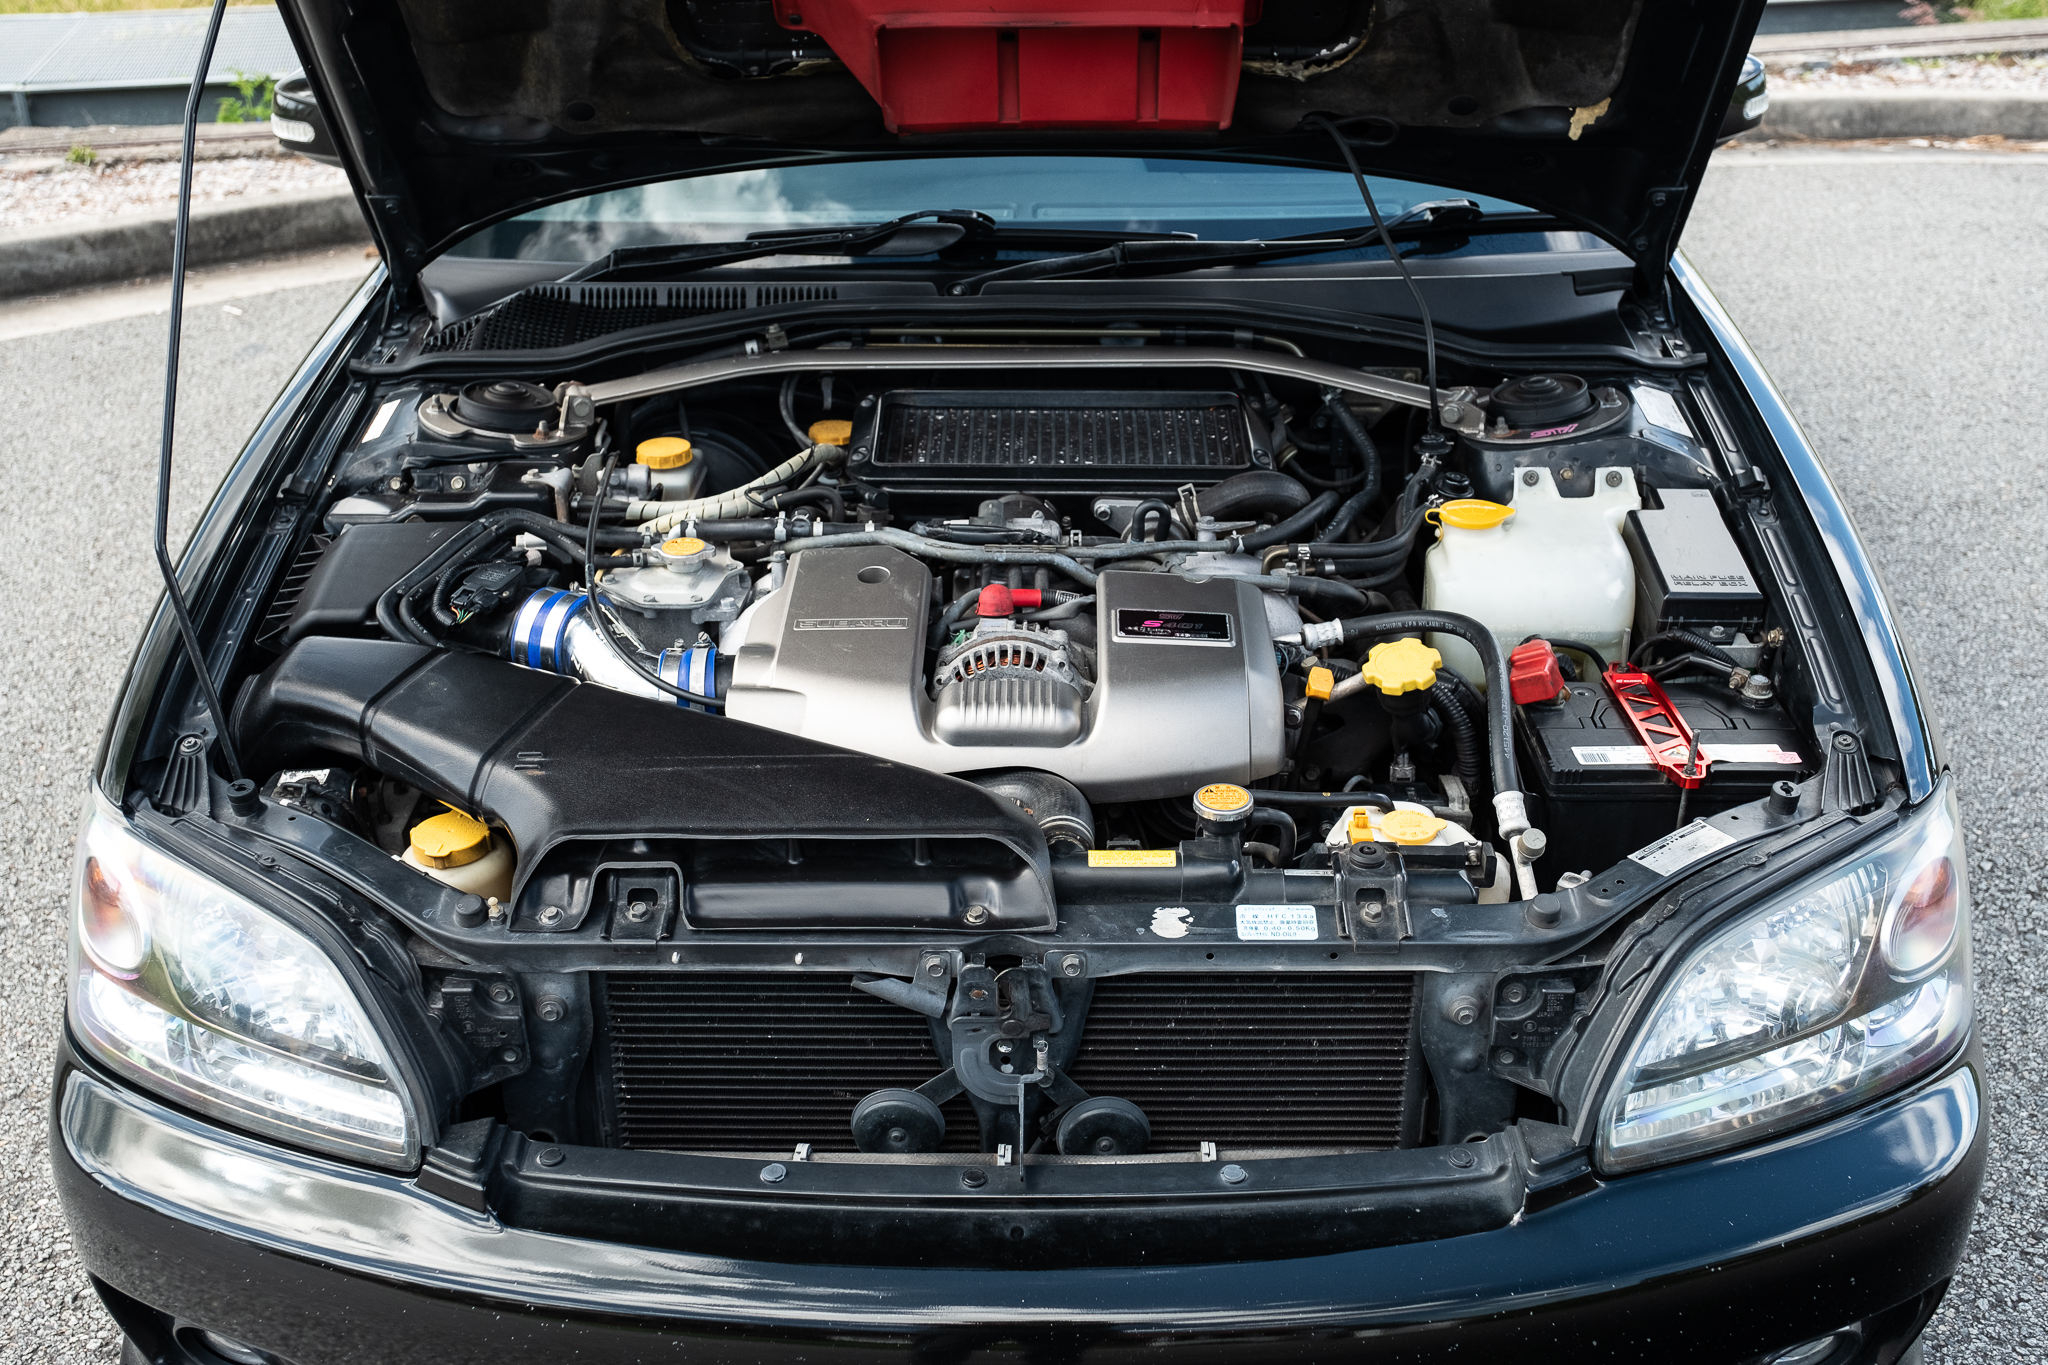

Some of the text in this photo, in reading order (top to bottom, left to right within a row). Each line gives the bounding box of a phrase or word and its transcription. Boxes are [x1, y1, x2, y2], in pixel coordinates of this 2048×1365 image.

[799, 619, 903, 628] SUBARU
[1141, 620, 1204, 629] S401
[1563, 625, 1602, 633] MITSUBA
